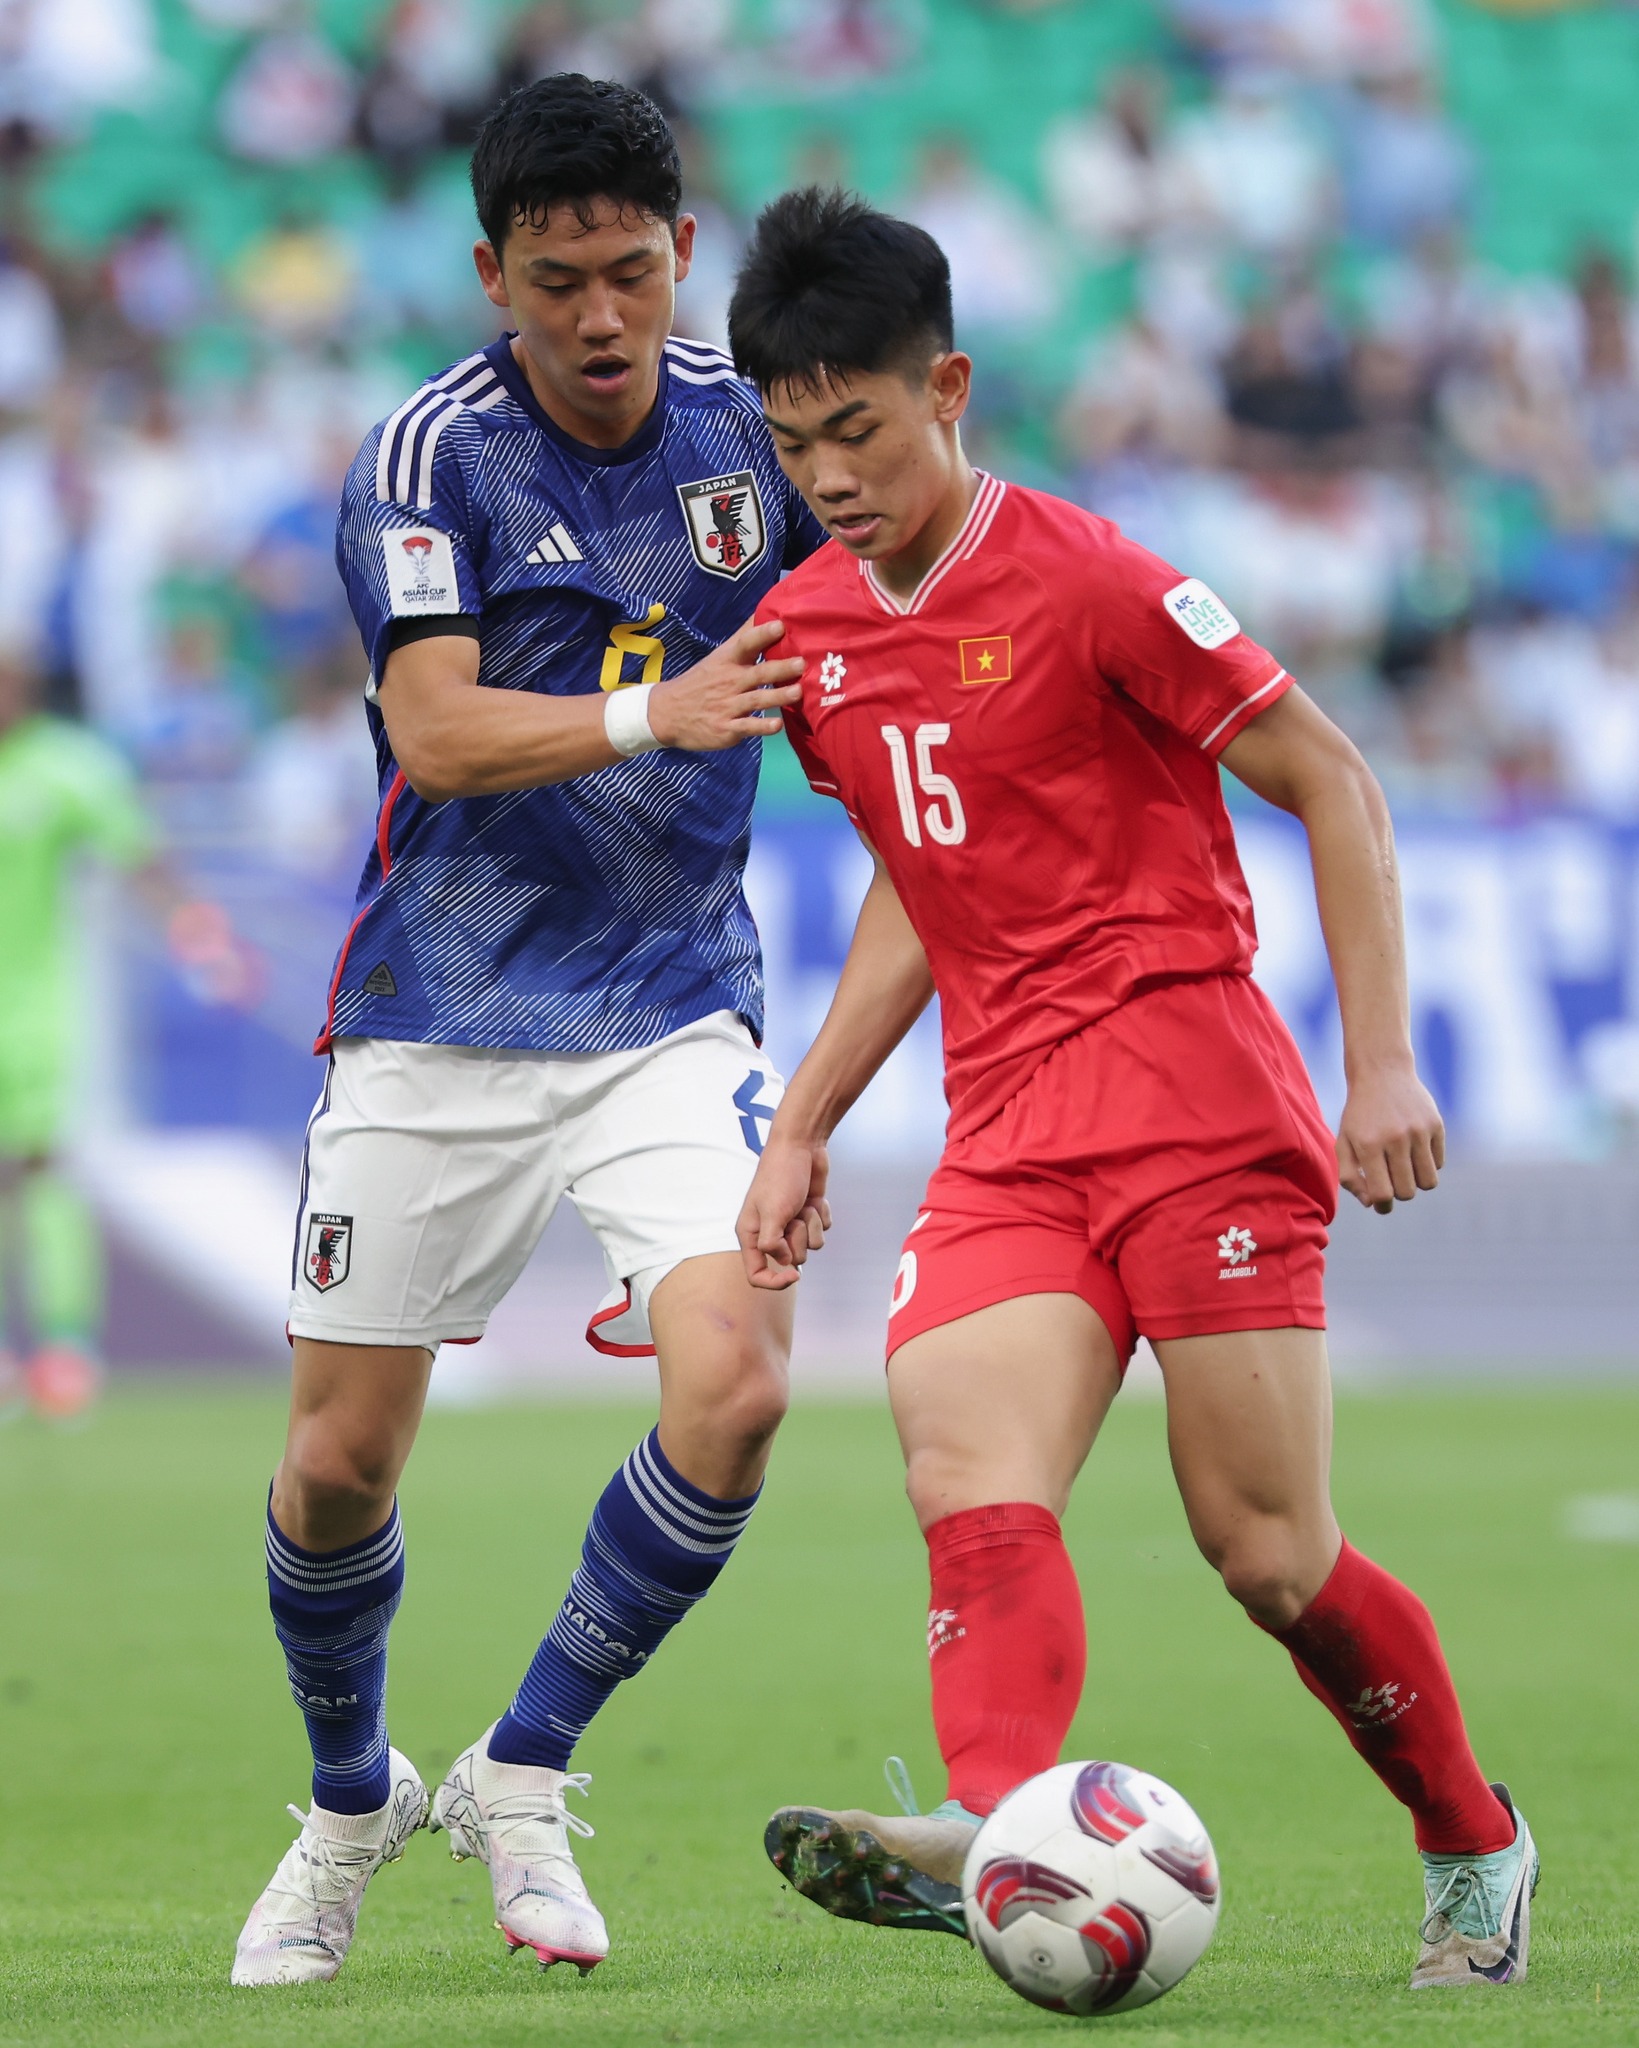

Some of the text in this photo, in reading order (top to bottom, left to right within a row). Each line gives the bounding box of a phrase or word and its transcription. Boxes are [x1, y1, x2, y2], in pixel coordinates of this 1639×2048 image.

[698, 477, 737, 494] JAPAN
[717, 542, 747, 563] JFA
[402, 588, 447, 597] ASIAN CUP
[405, 594, 427, 603] QATAR
[1174, 595, 1195, 612] AFC
[1182, 598, 1218, 627] LIVE
[599, 602, 666, 692] 6
[881, 723, 967, 847] 15
[317, 1214, 342, 1224] JAPAN
